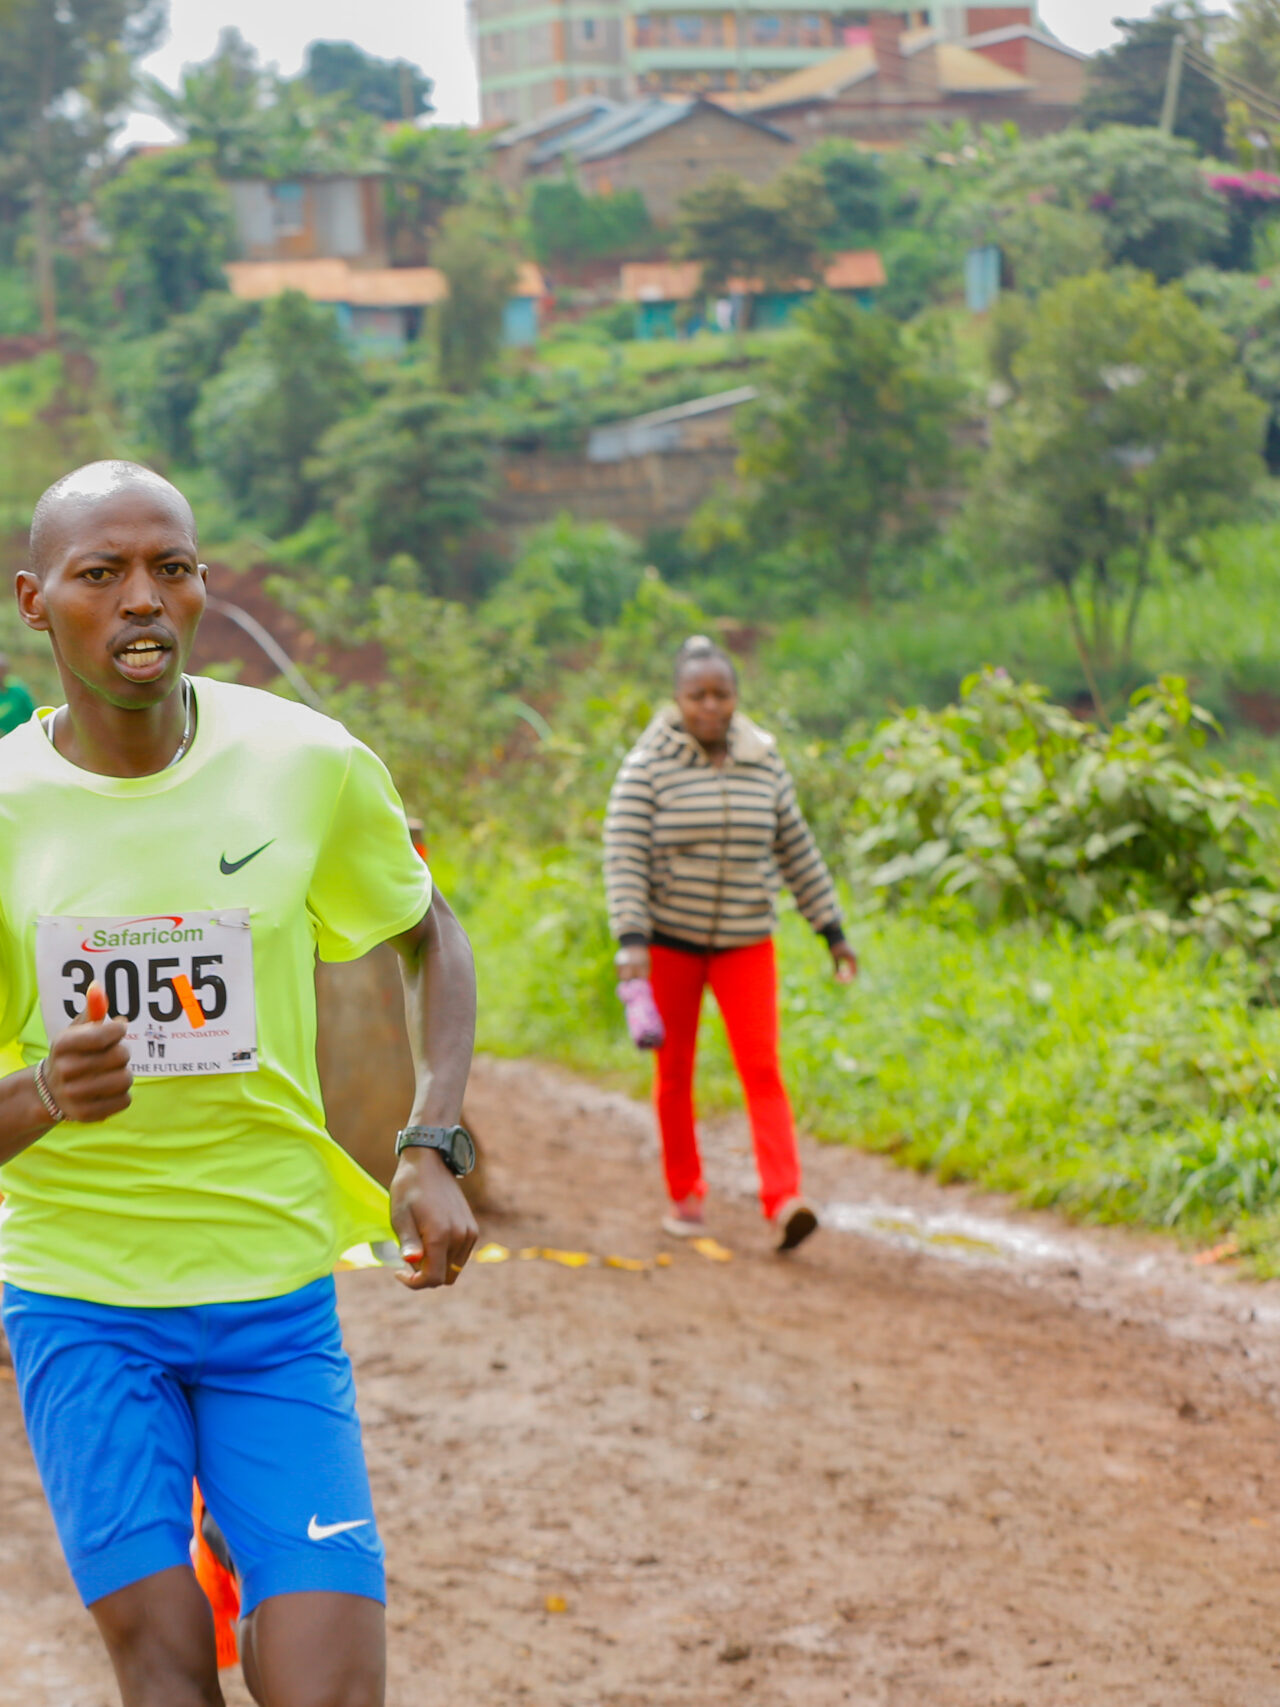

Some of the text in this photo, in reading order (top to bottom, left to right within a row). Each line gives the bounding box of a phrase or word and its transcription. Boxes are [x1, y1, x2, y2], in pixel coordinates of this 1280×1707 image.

[92, 926, 203, 947] Safaricom
[61, 955, 227, 1023] 3055
[171, 1029, 230, 1039] FOUNDATION
[131, 1061, 222, 1072] THE FUTURE RUN
